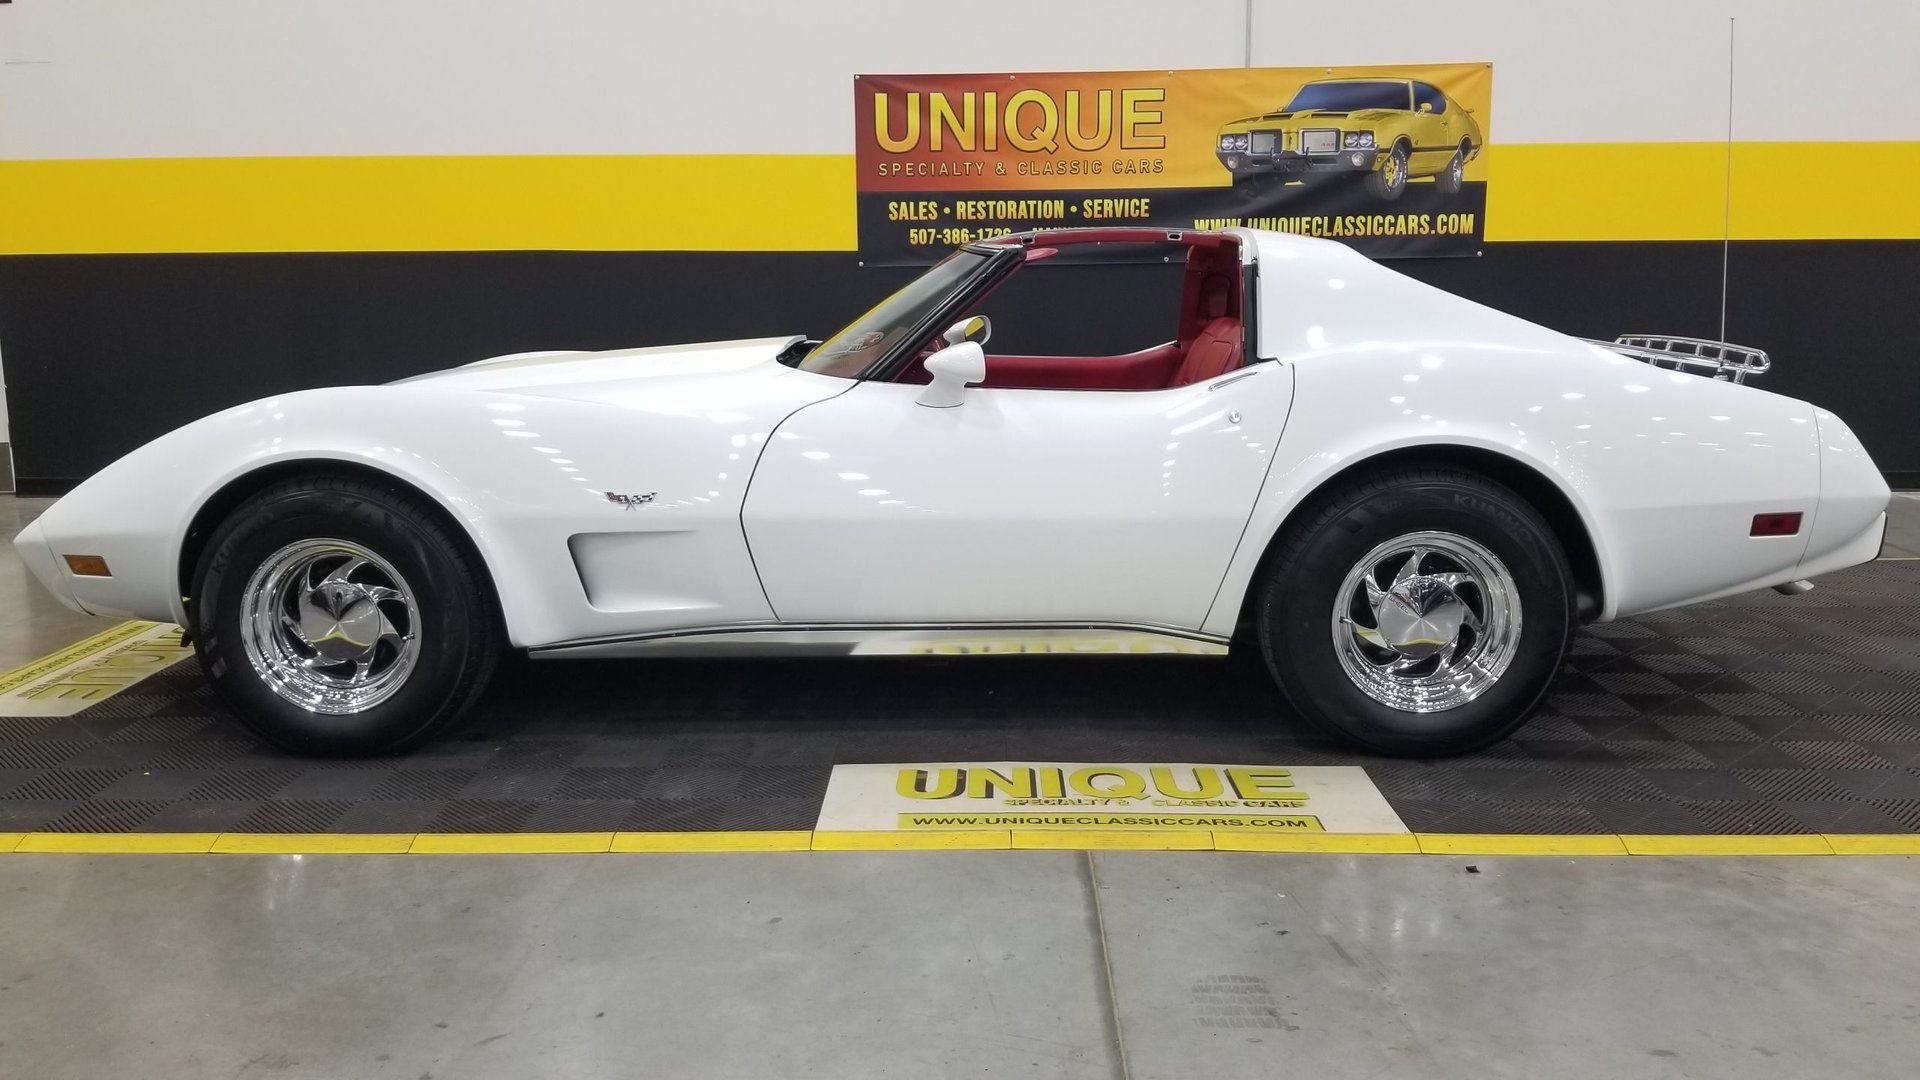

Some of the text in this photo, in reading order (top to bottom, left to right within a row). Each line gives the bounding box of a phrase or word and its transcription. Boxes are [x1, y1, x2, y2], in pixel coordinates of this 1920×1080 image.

[874, 88, 1165, 154] UNIQUE
[878, 159, 1163, 176] SPECIALTY & CLASSIC CARS
[888, 198, 1150, 221] SALES RESTORATION SERVICE
[896, 767, 1310, 799] UNIQUE
[913, 817, 1307, 828] WWW.UNIQUECLASSICCARS.COM
